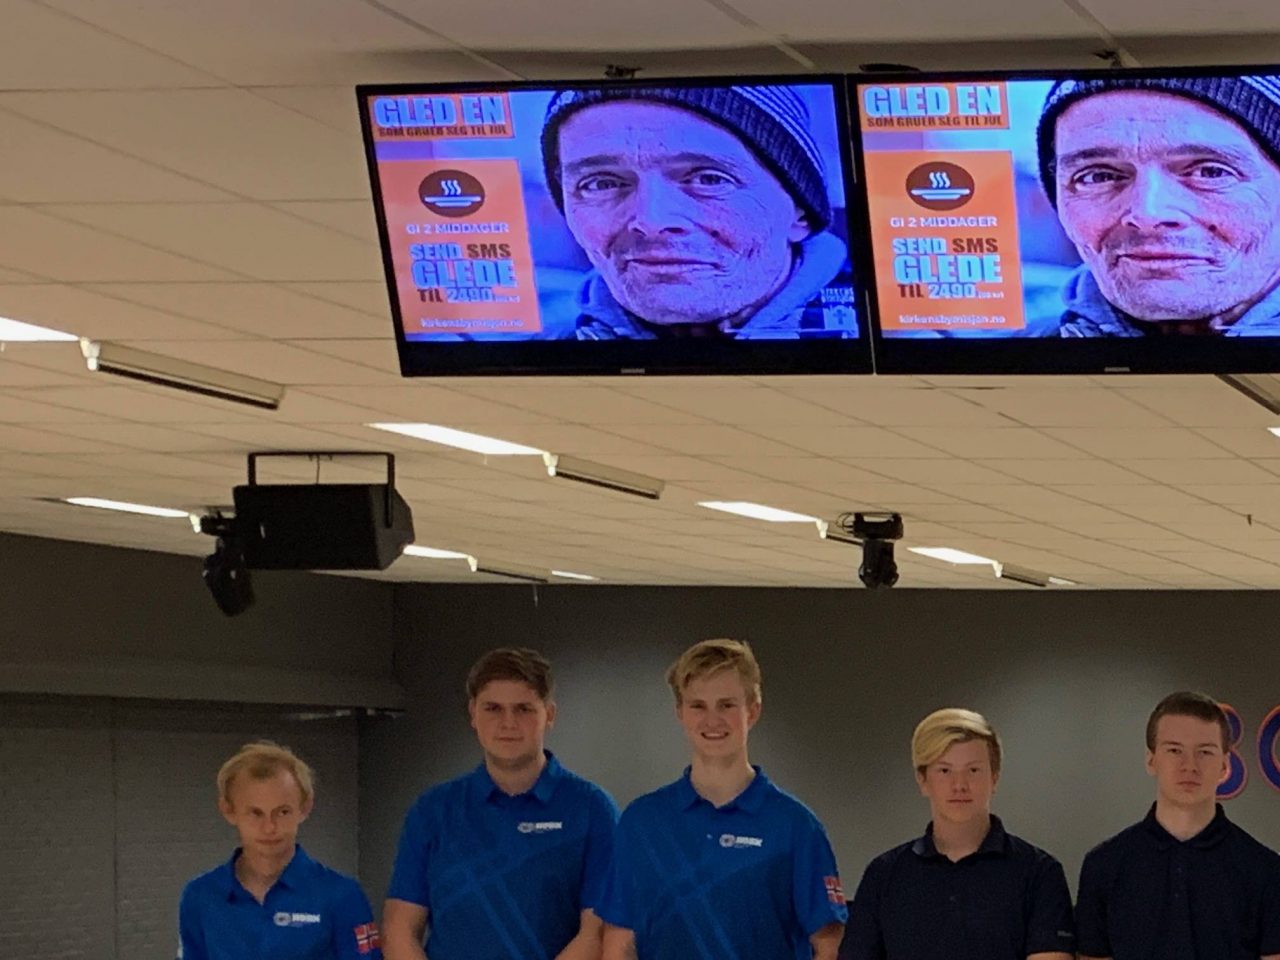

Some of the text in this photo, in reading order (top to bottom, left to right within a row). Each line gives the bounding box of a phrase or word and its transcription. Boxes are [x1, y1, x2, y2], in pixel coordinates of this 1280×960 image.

[864, 85, 1002, 118] GLED EN
[374, 95, 506, 127] GLED EN
[868, 117, 895, 127] SOM
[423, 224, 433, 234] 2
[435, 223, 510, 234] MIDDAGER
[890, 216, 998, 228] GI 2 MIDDAGER
[410, 243, 511, 260] SEND SMS
[892, 237, 998, 254] SEND SMS
[412, 259, 518, 289] GLEDE
[894, 254, 1003, 284] GLEDE
[417, 288, 443, 303] TIL
[897, 284, 924, 298] TIL
[928, 283, 977, 299] 2490
